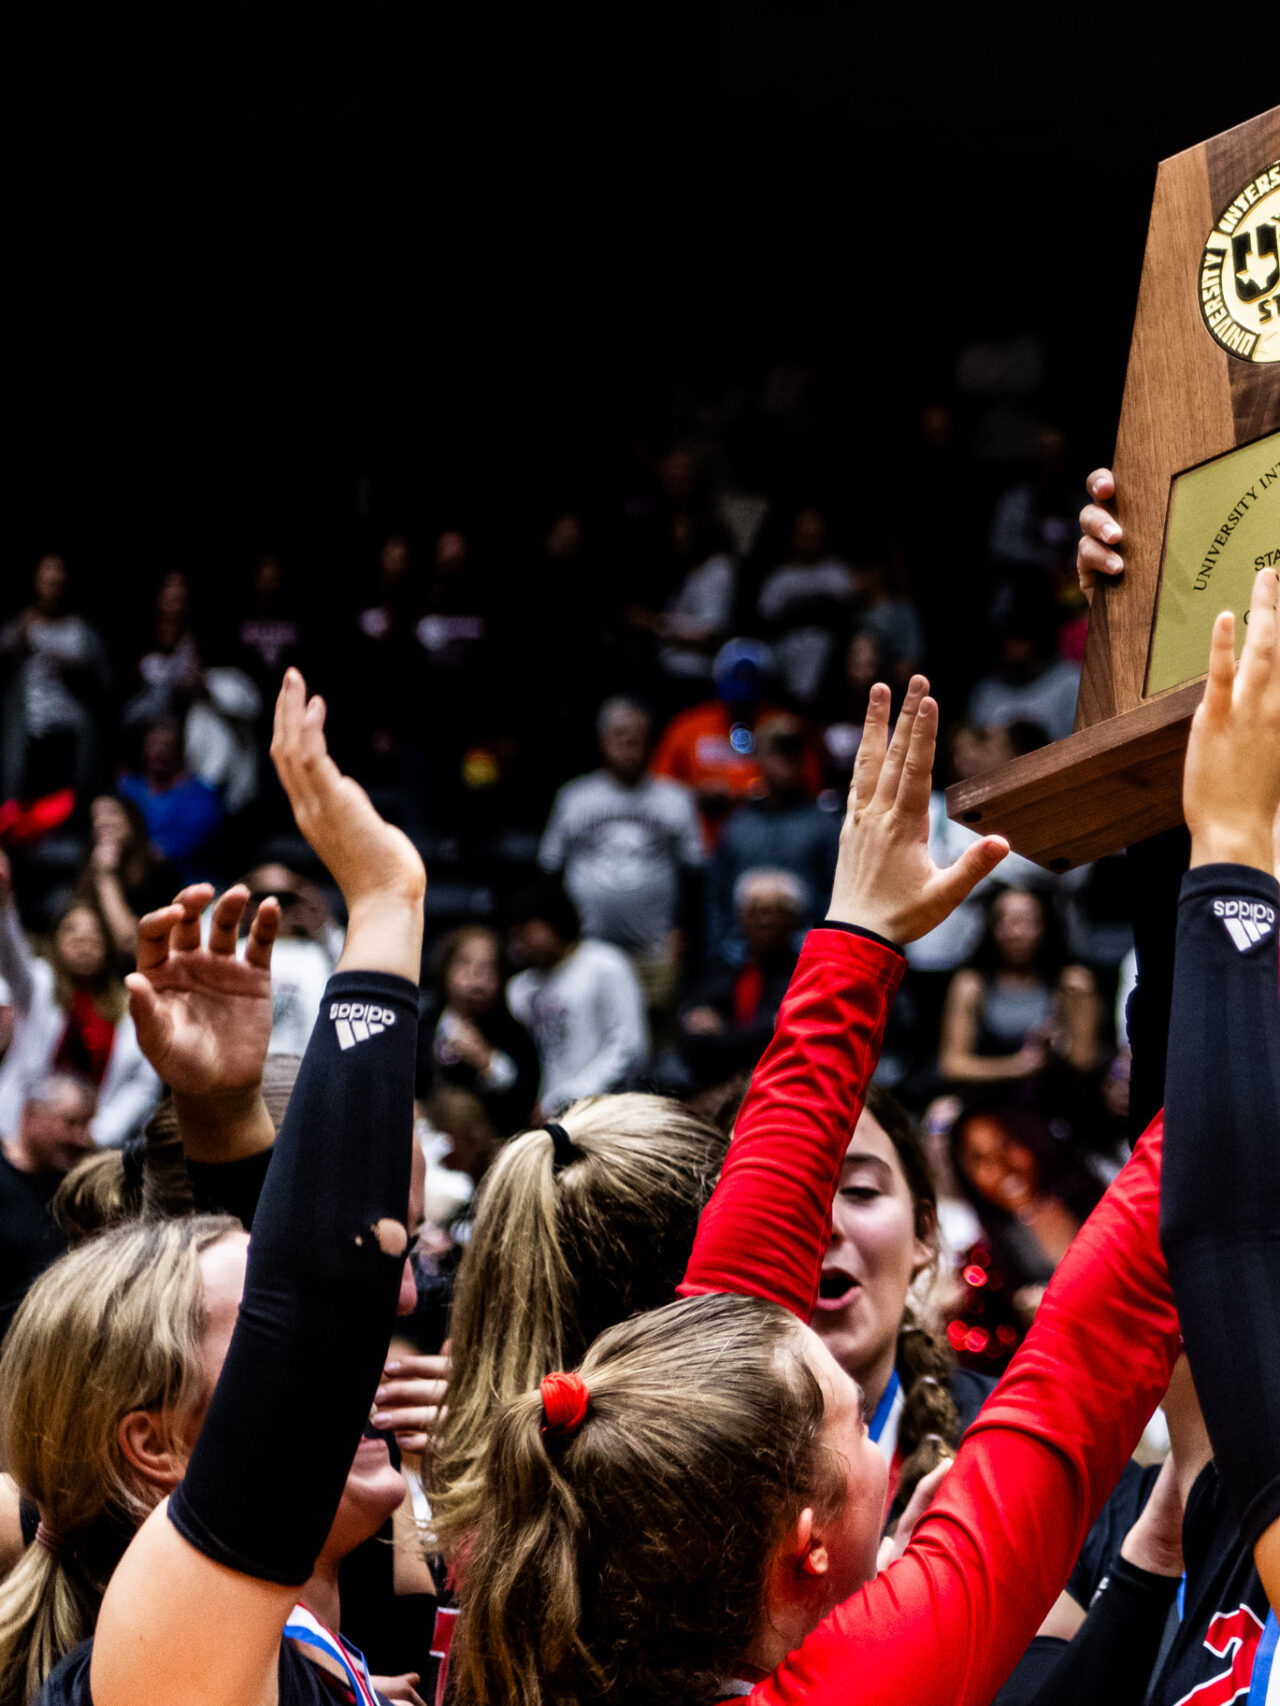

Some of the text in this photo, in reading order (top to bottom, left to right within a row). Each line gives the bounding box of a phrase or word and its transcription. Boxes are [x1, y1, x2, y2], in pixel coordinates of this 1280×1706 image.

[1201, 254, 1257, 356] UNIVERSITY
[1193, 487, 1258, 592] UNIVERSITY
[1213, 900, 1275, 924] adidas
[329, 1003, 395, 1026] adidas
